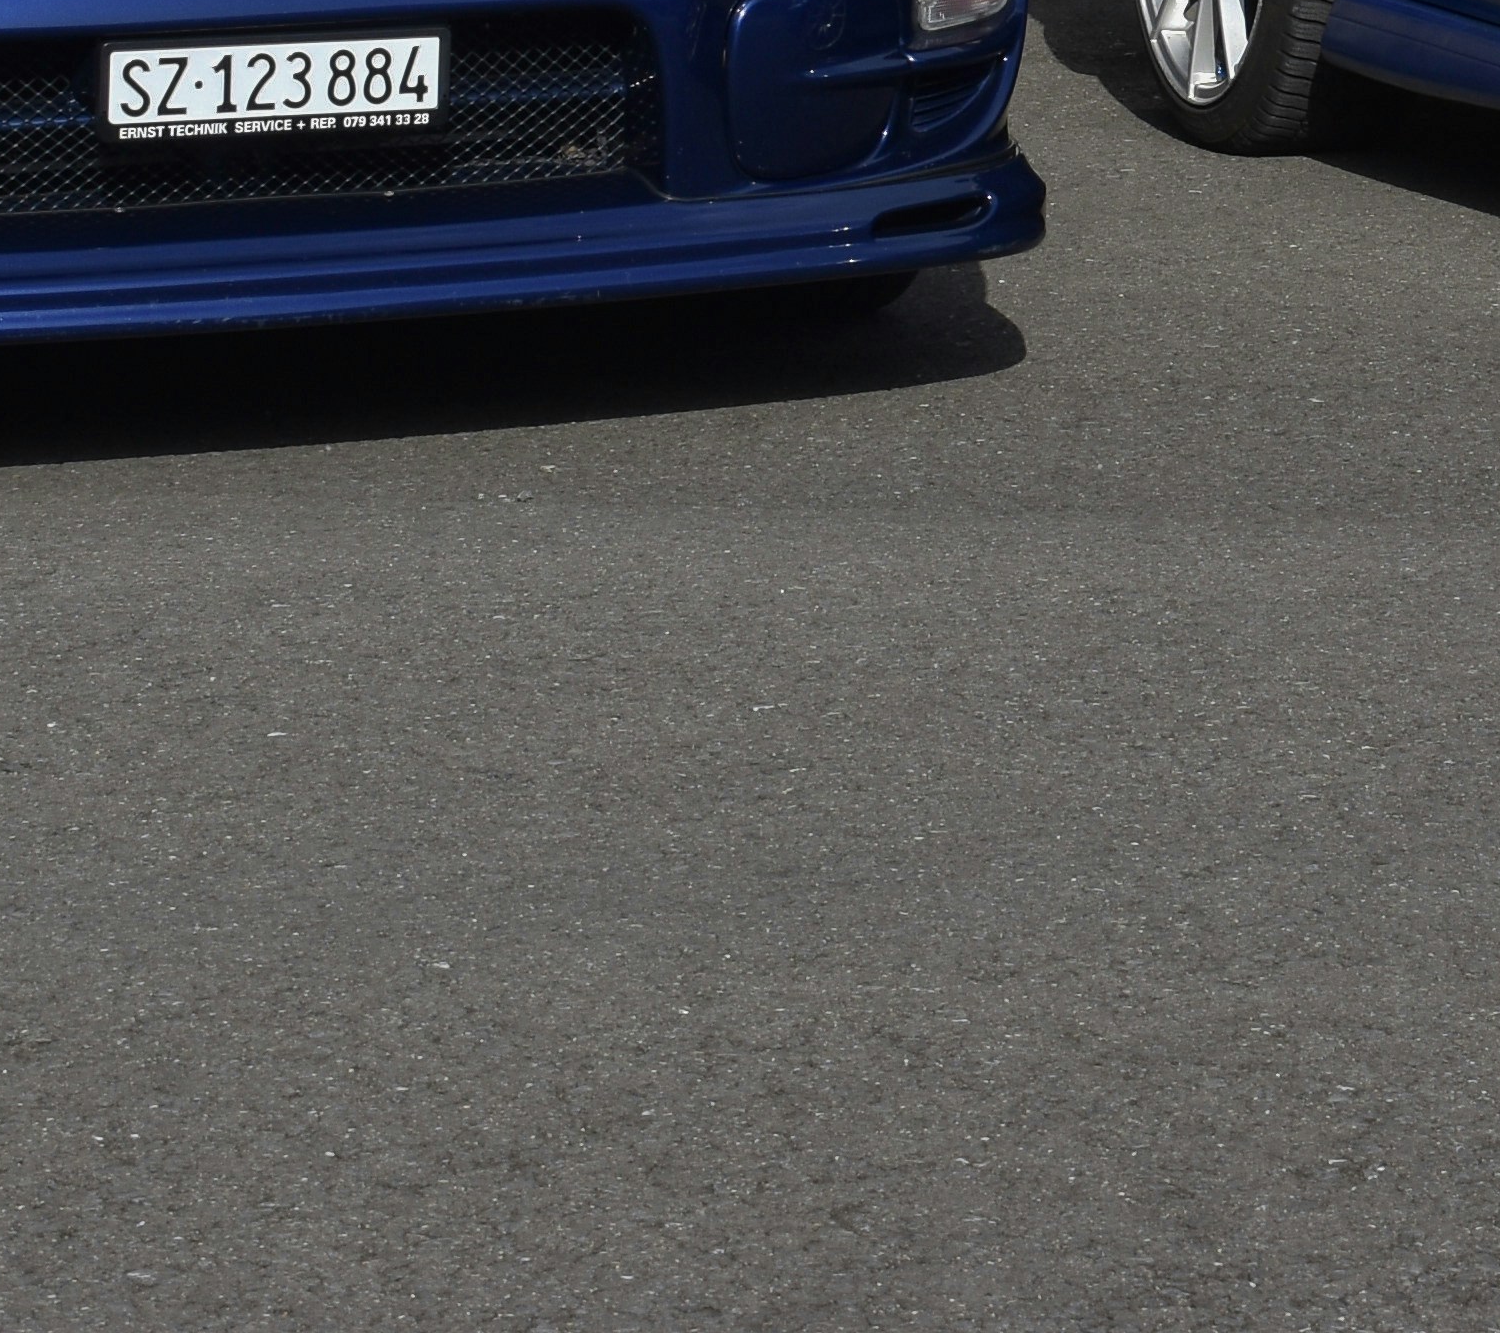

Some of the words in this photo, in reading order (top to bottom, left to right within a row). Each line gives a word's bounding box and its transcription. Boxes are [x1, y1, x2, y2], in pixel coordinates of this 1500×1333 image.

[119, 126, 165, 140] ERNST
[168, 123, 228, 137] TECHNIK
[234, 119, 292, 134] SERVICE
[310, 117, 337, 130] REP.
[343, 115, 367, 128] 079
[369, 114, 393, 127] 341
[395, 114, 411, 126] 33
[413, 113, 430, 125] 28
